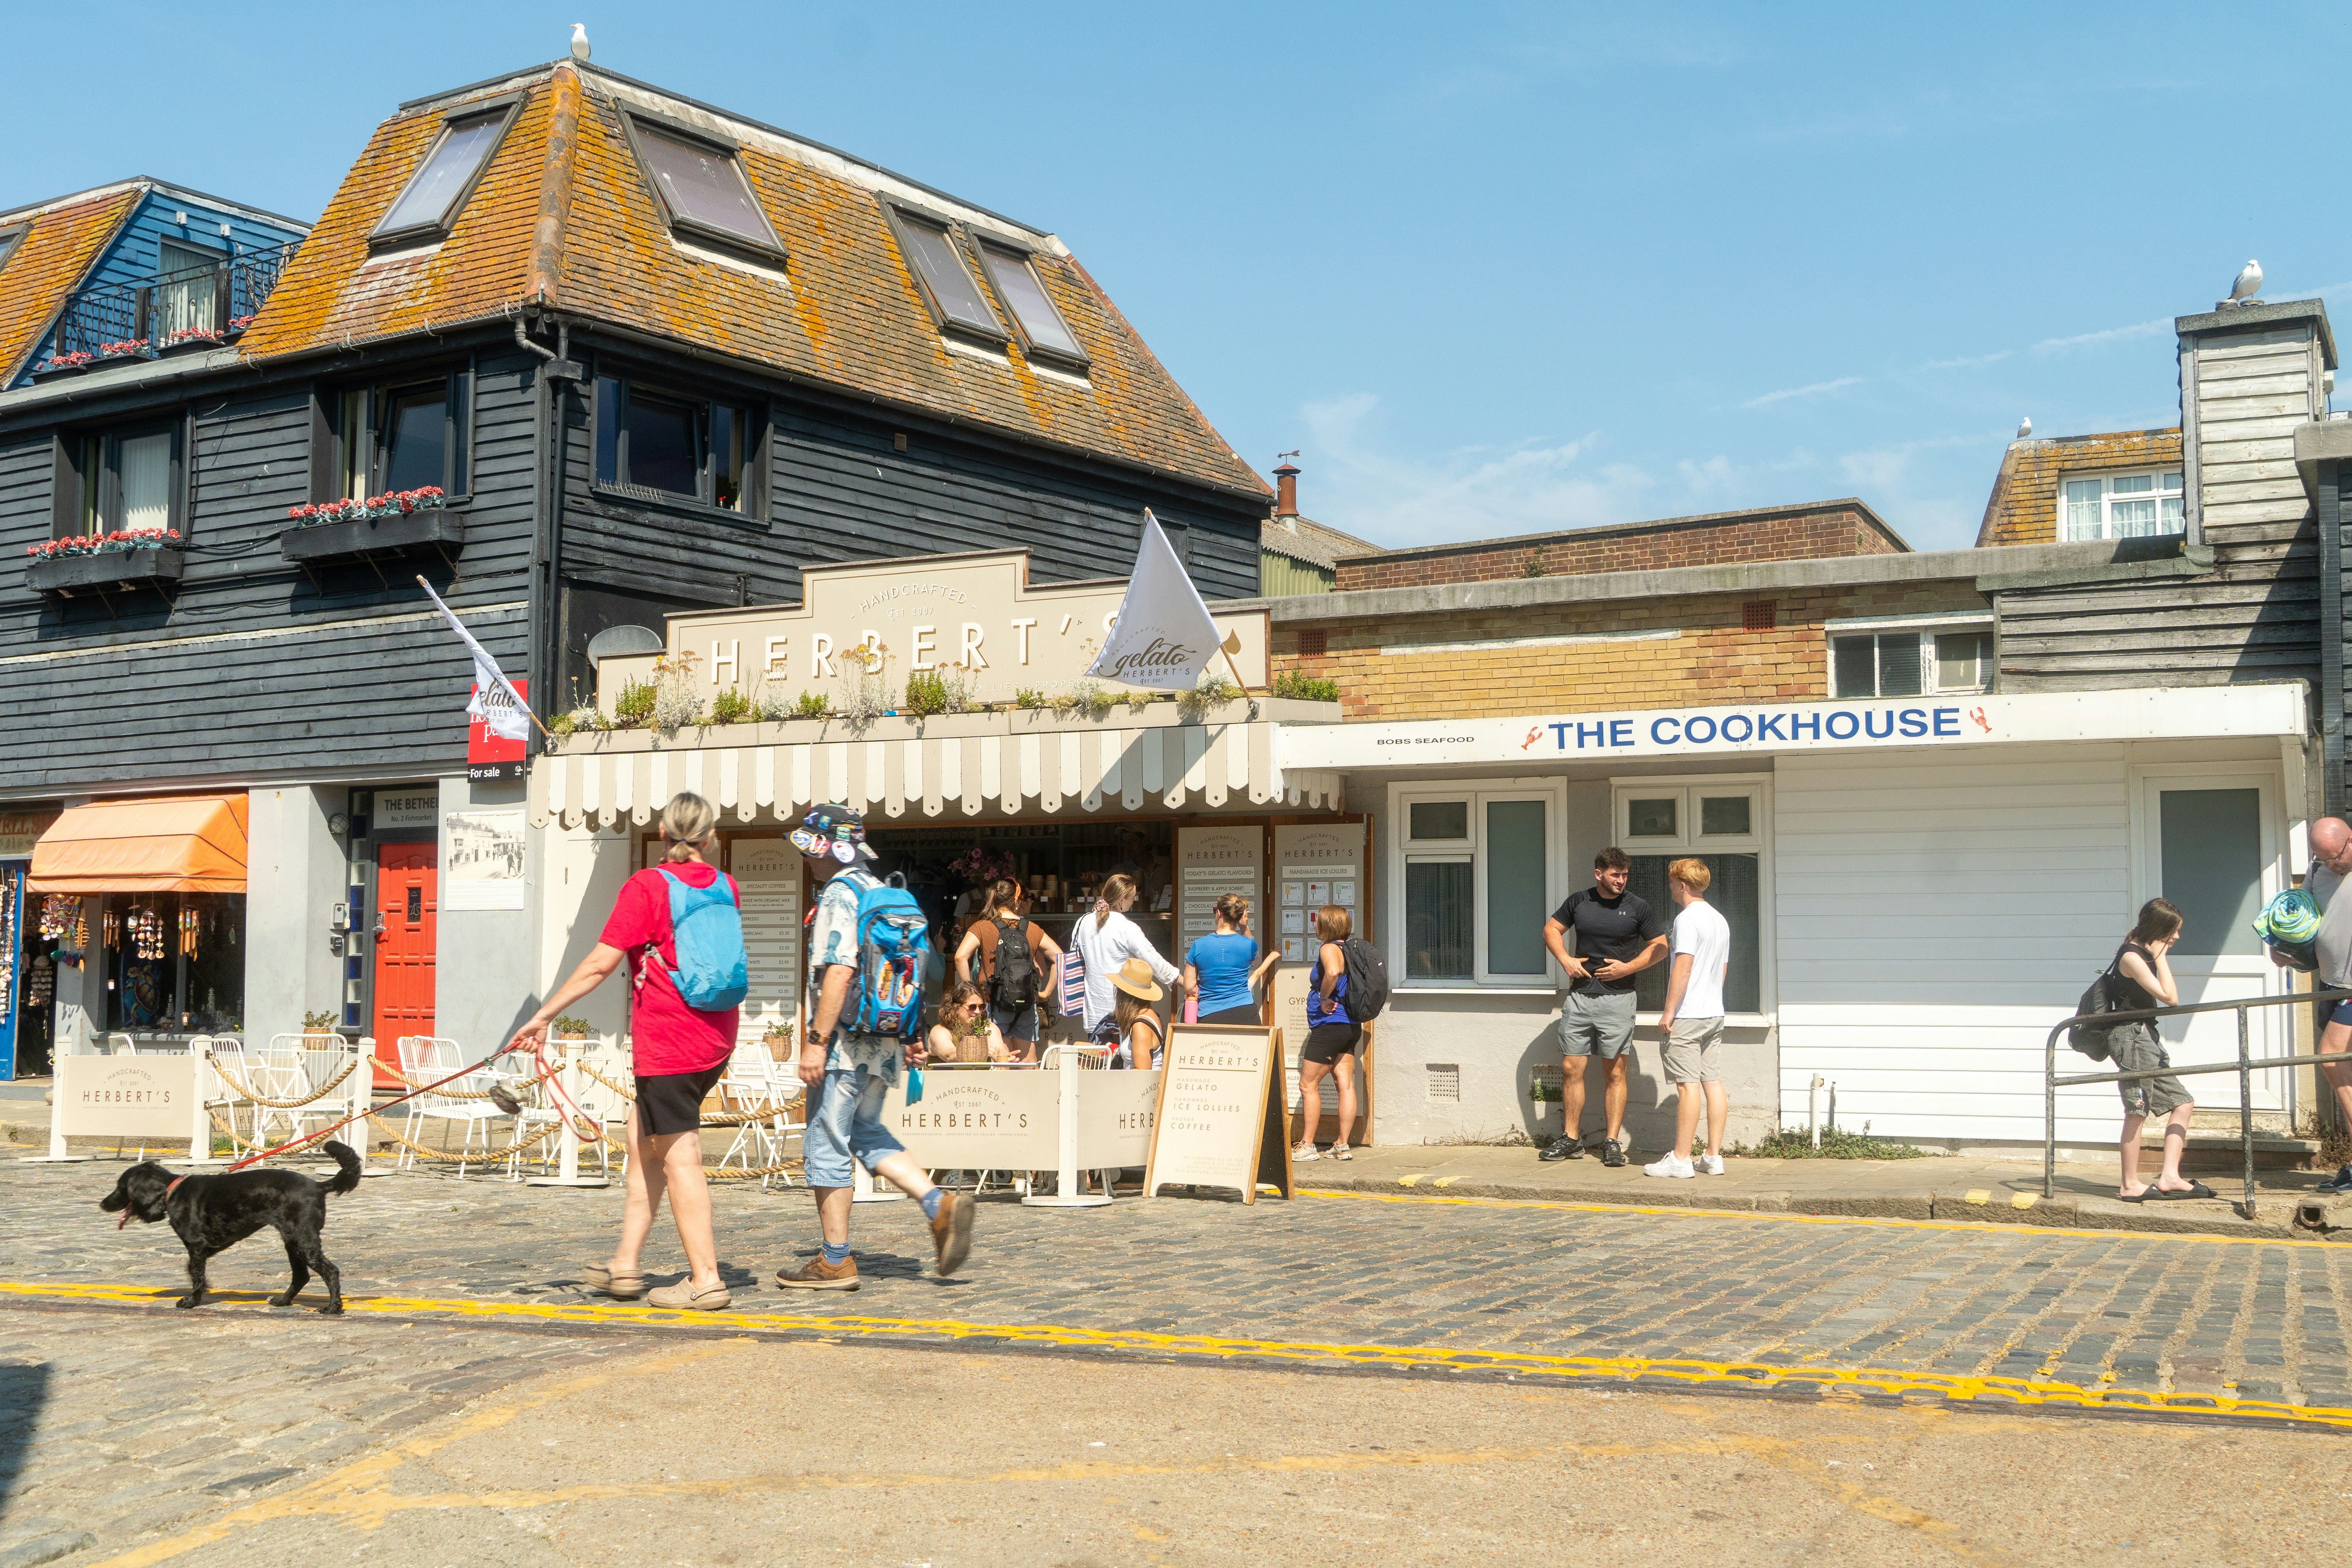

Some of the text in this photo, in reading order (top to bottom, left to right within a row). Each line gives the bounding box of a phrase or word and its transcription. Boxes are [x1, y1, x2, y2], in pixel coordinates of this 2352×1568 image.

[859, 583, 967, 613] HANDCRAFTED
[912, 607, 934, 617] 2007
[1111, 627, 1165, 657] HANDCRAFTED
[1097, 637, 1198, 678] gelato
[1123, 668, 1190, 678] HERBERT'S
[479, 677, 517, 708] elato
[486, 709, 523, 718] RBERT'S
[1548, 707, 1962, 750] THE COOKHOUSE
[470, 766, 500, 778] For sale
[384, 798, 402, 811] THE
[405, 813, 432, 822] Fishmarket
[0, 815, 29, 835] ELL
[1200, 835, 1240, 845] HANDCRAFTED
[1298, 833, 1340, 843] HANDCRAFTED
[750, 849, 784, 858] HANDCRAFTED
[1187, 850, 1253, 859] HERBERT'S
[1284, 849, 1353, 858] HERBERT'S
[1289, 997, 1308, 1005] GYP
[1200, 1041, 1240, 1051] HANDCRAFTED
[1179, 1055, 1258, 1067] HERBERT'S
[107, 1068, 152, 1081] HANDCRAFTED
[83, 1090, 170, 1103] HERBERT'S
[936, 1086, 999, 1101] HANDCRAFTED
[902, 1113, 1027, 1128] HERBERT'S
